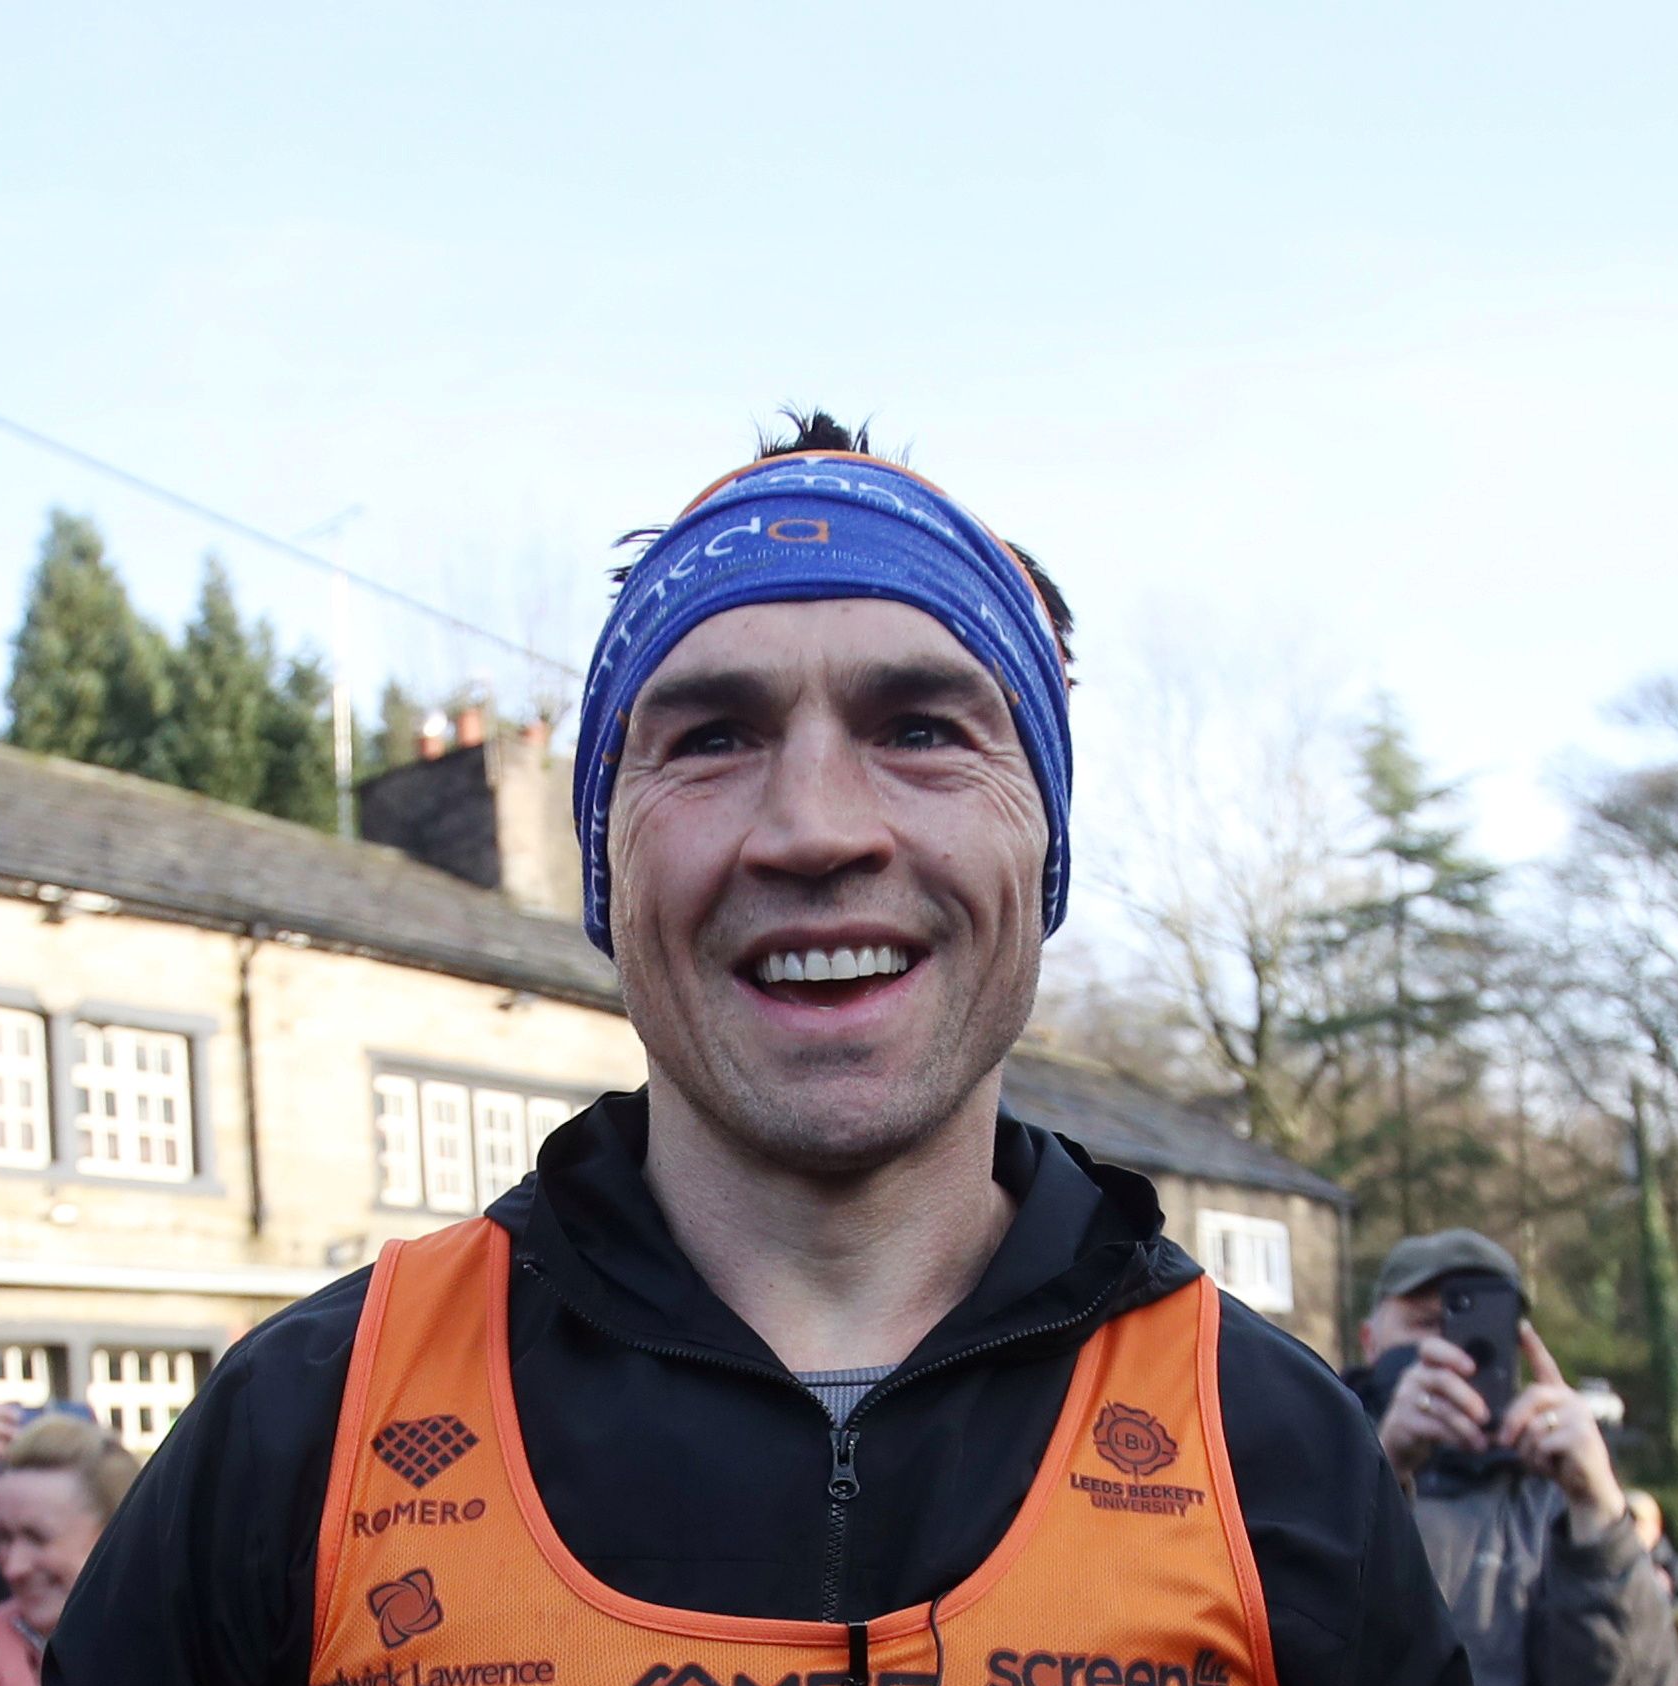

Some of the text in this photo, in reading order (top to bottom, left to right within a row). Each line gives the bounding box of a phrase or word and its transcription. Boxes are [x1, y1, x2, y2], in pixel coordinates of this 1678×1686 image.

[1070, 1473, 1204, 1505] LEEDS BECKETT
[1091, 1493, 1188, 1517] UNIVERSITY
[353, 1498, 486, 1537] ROMERO
